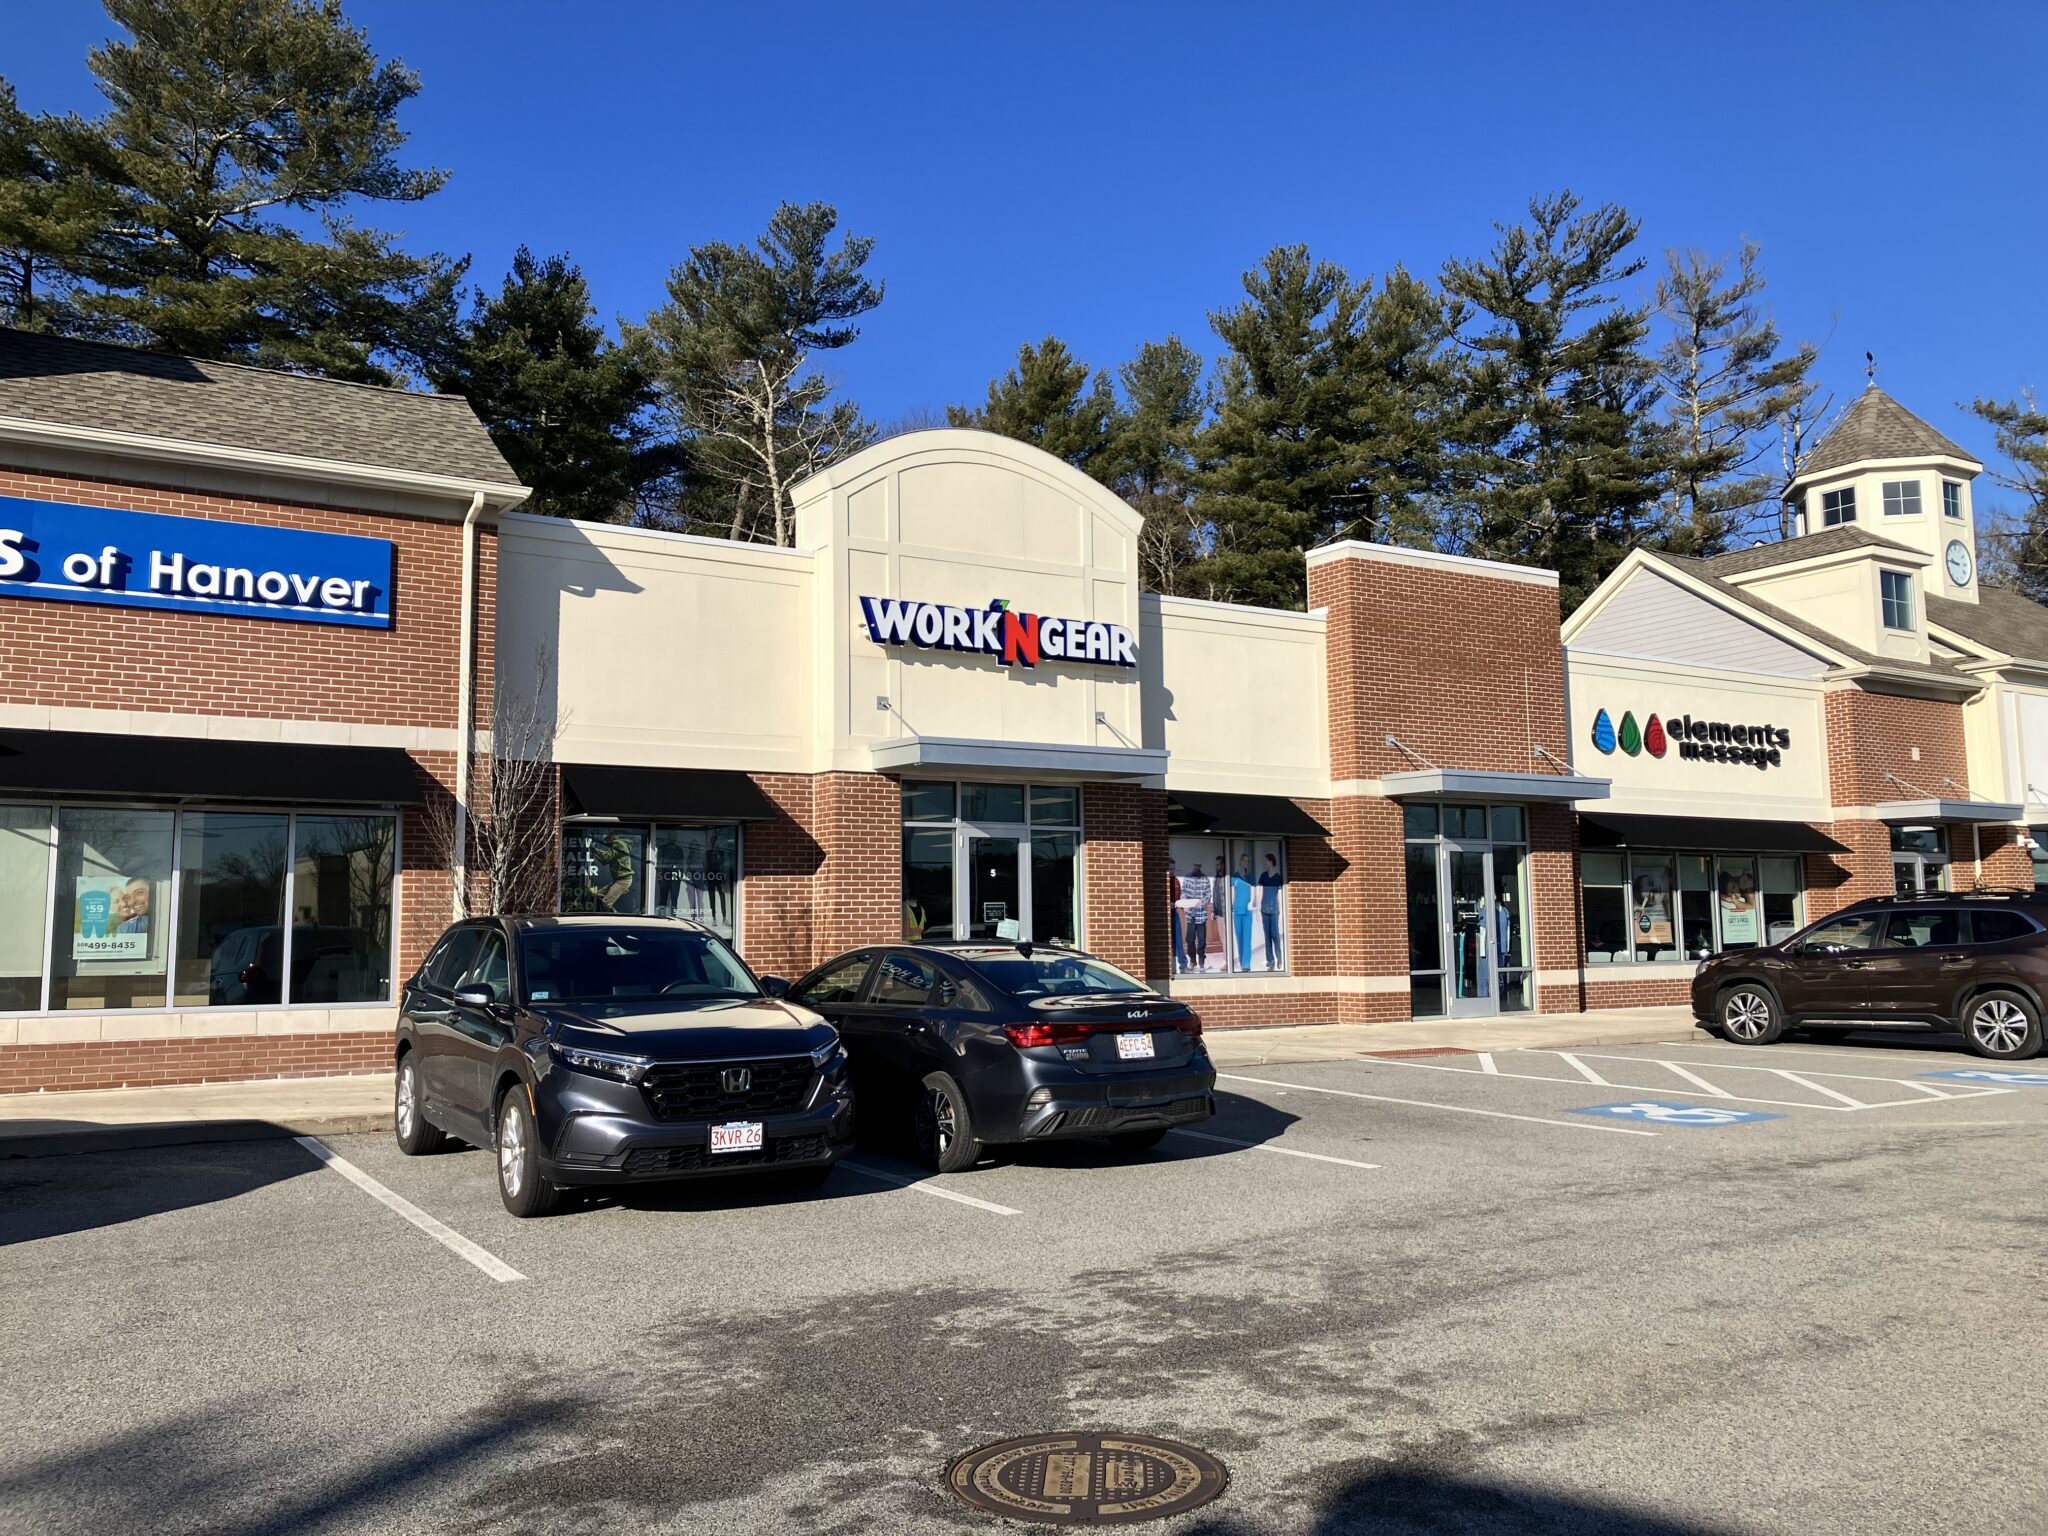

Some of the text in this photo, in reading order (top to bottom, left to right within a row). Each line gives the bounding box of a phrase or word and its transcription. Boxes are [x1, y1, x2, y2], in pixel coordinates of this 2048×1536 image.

[62, 545, 118, 584] of
[149, 550, 371, 609] Hanover
[1666, 714, 1790, 748] elements
[1679, 741, 1782, 769] massage
[657, 871, 728, 881] SCRUBOLOGY
[989, 868, 997, 878] 5
[1140, 1037, 1152, 1051] 54
[711, 1128, 761, 1146] 3KVR 26
